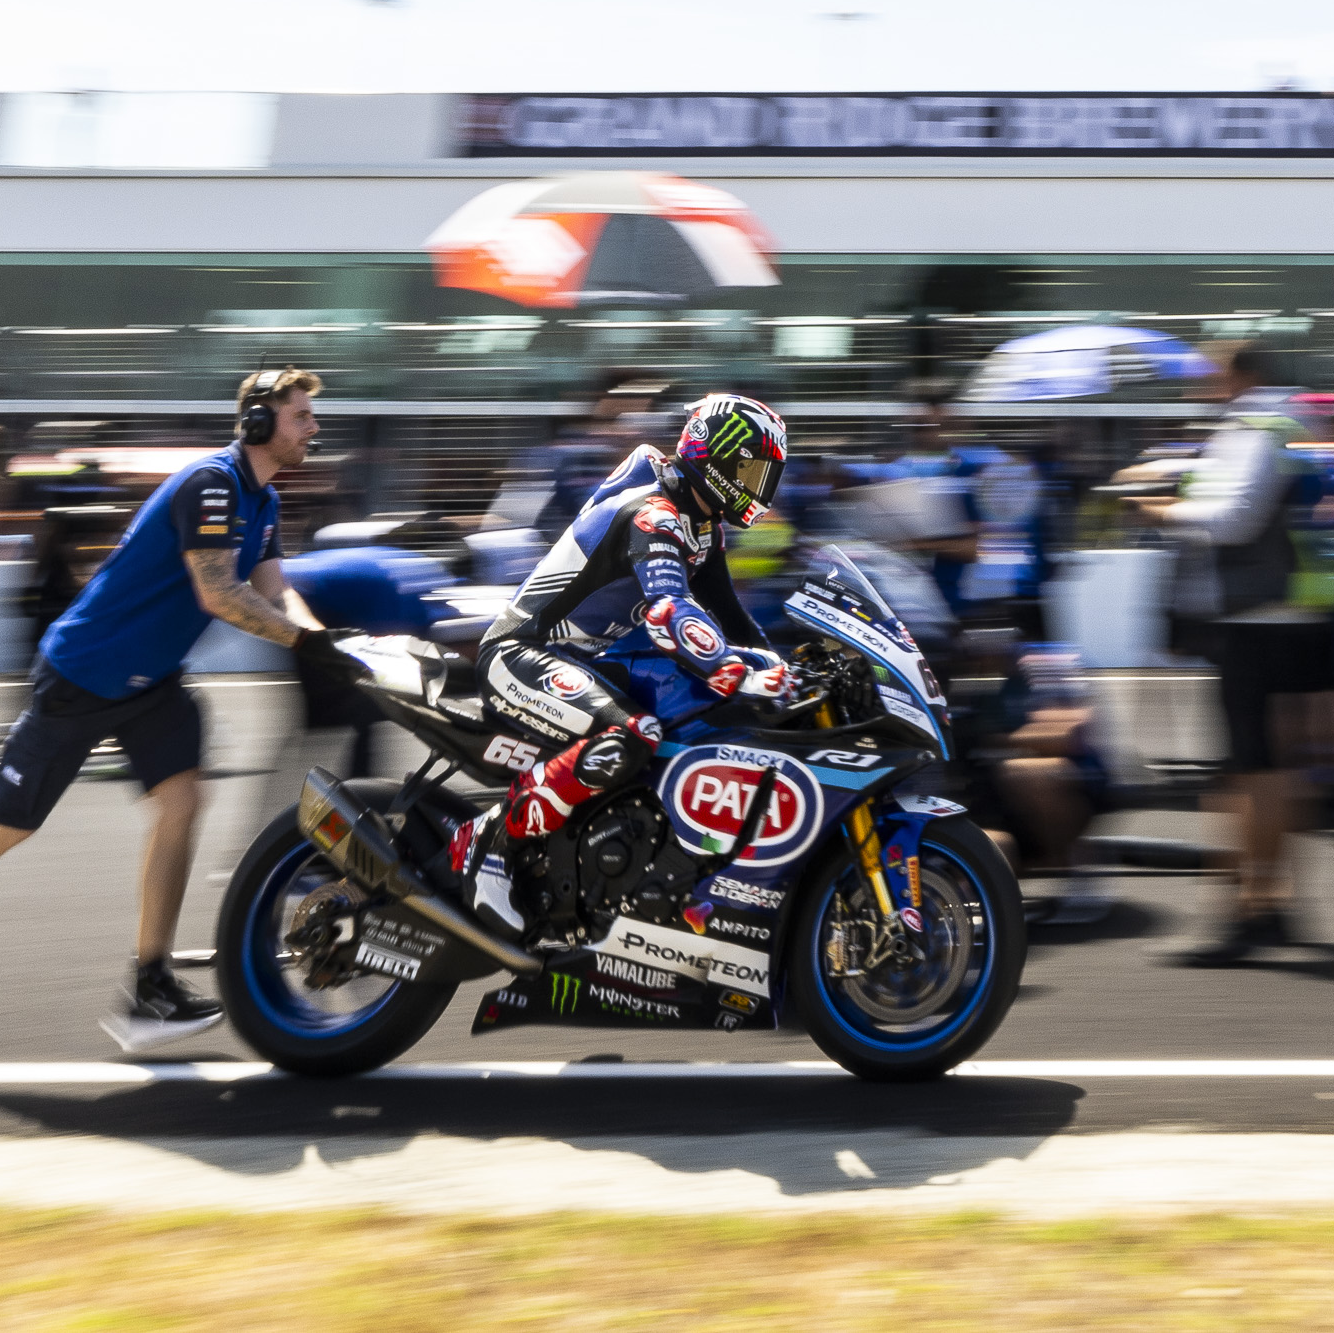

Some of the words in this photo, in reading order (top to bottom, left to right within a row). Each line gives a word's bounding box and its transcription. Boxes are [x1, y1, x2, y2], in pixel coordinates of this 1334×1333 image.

[489, 695, 570, 743] alpinestars
[505, 681, 565, 721] PROMETEON
[483, 734, 542, 773] 65
[718, 746, 781, 770] SNACK
[805, 748, 883, 768] R1
[708, 916, 771, 941] AMPITO
[595, 952, 678, 990] YAMALUBE
[617, 931, 769, 985] PROMETEON
[589, 983, 681, 1019] MONSTER
